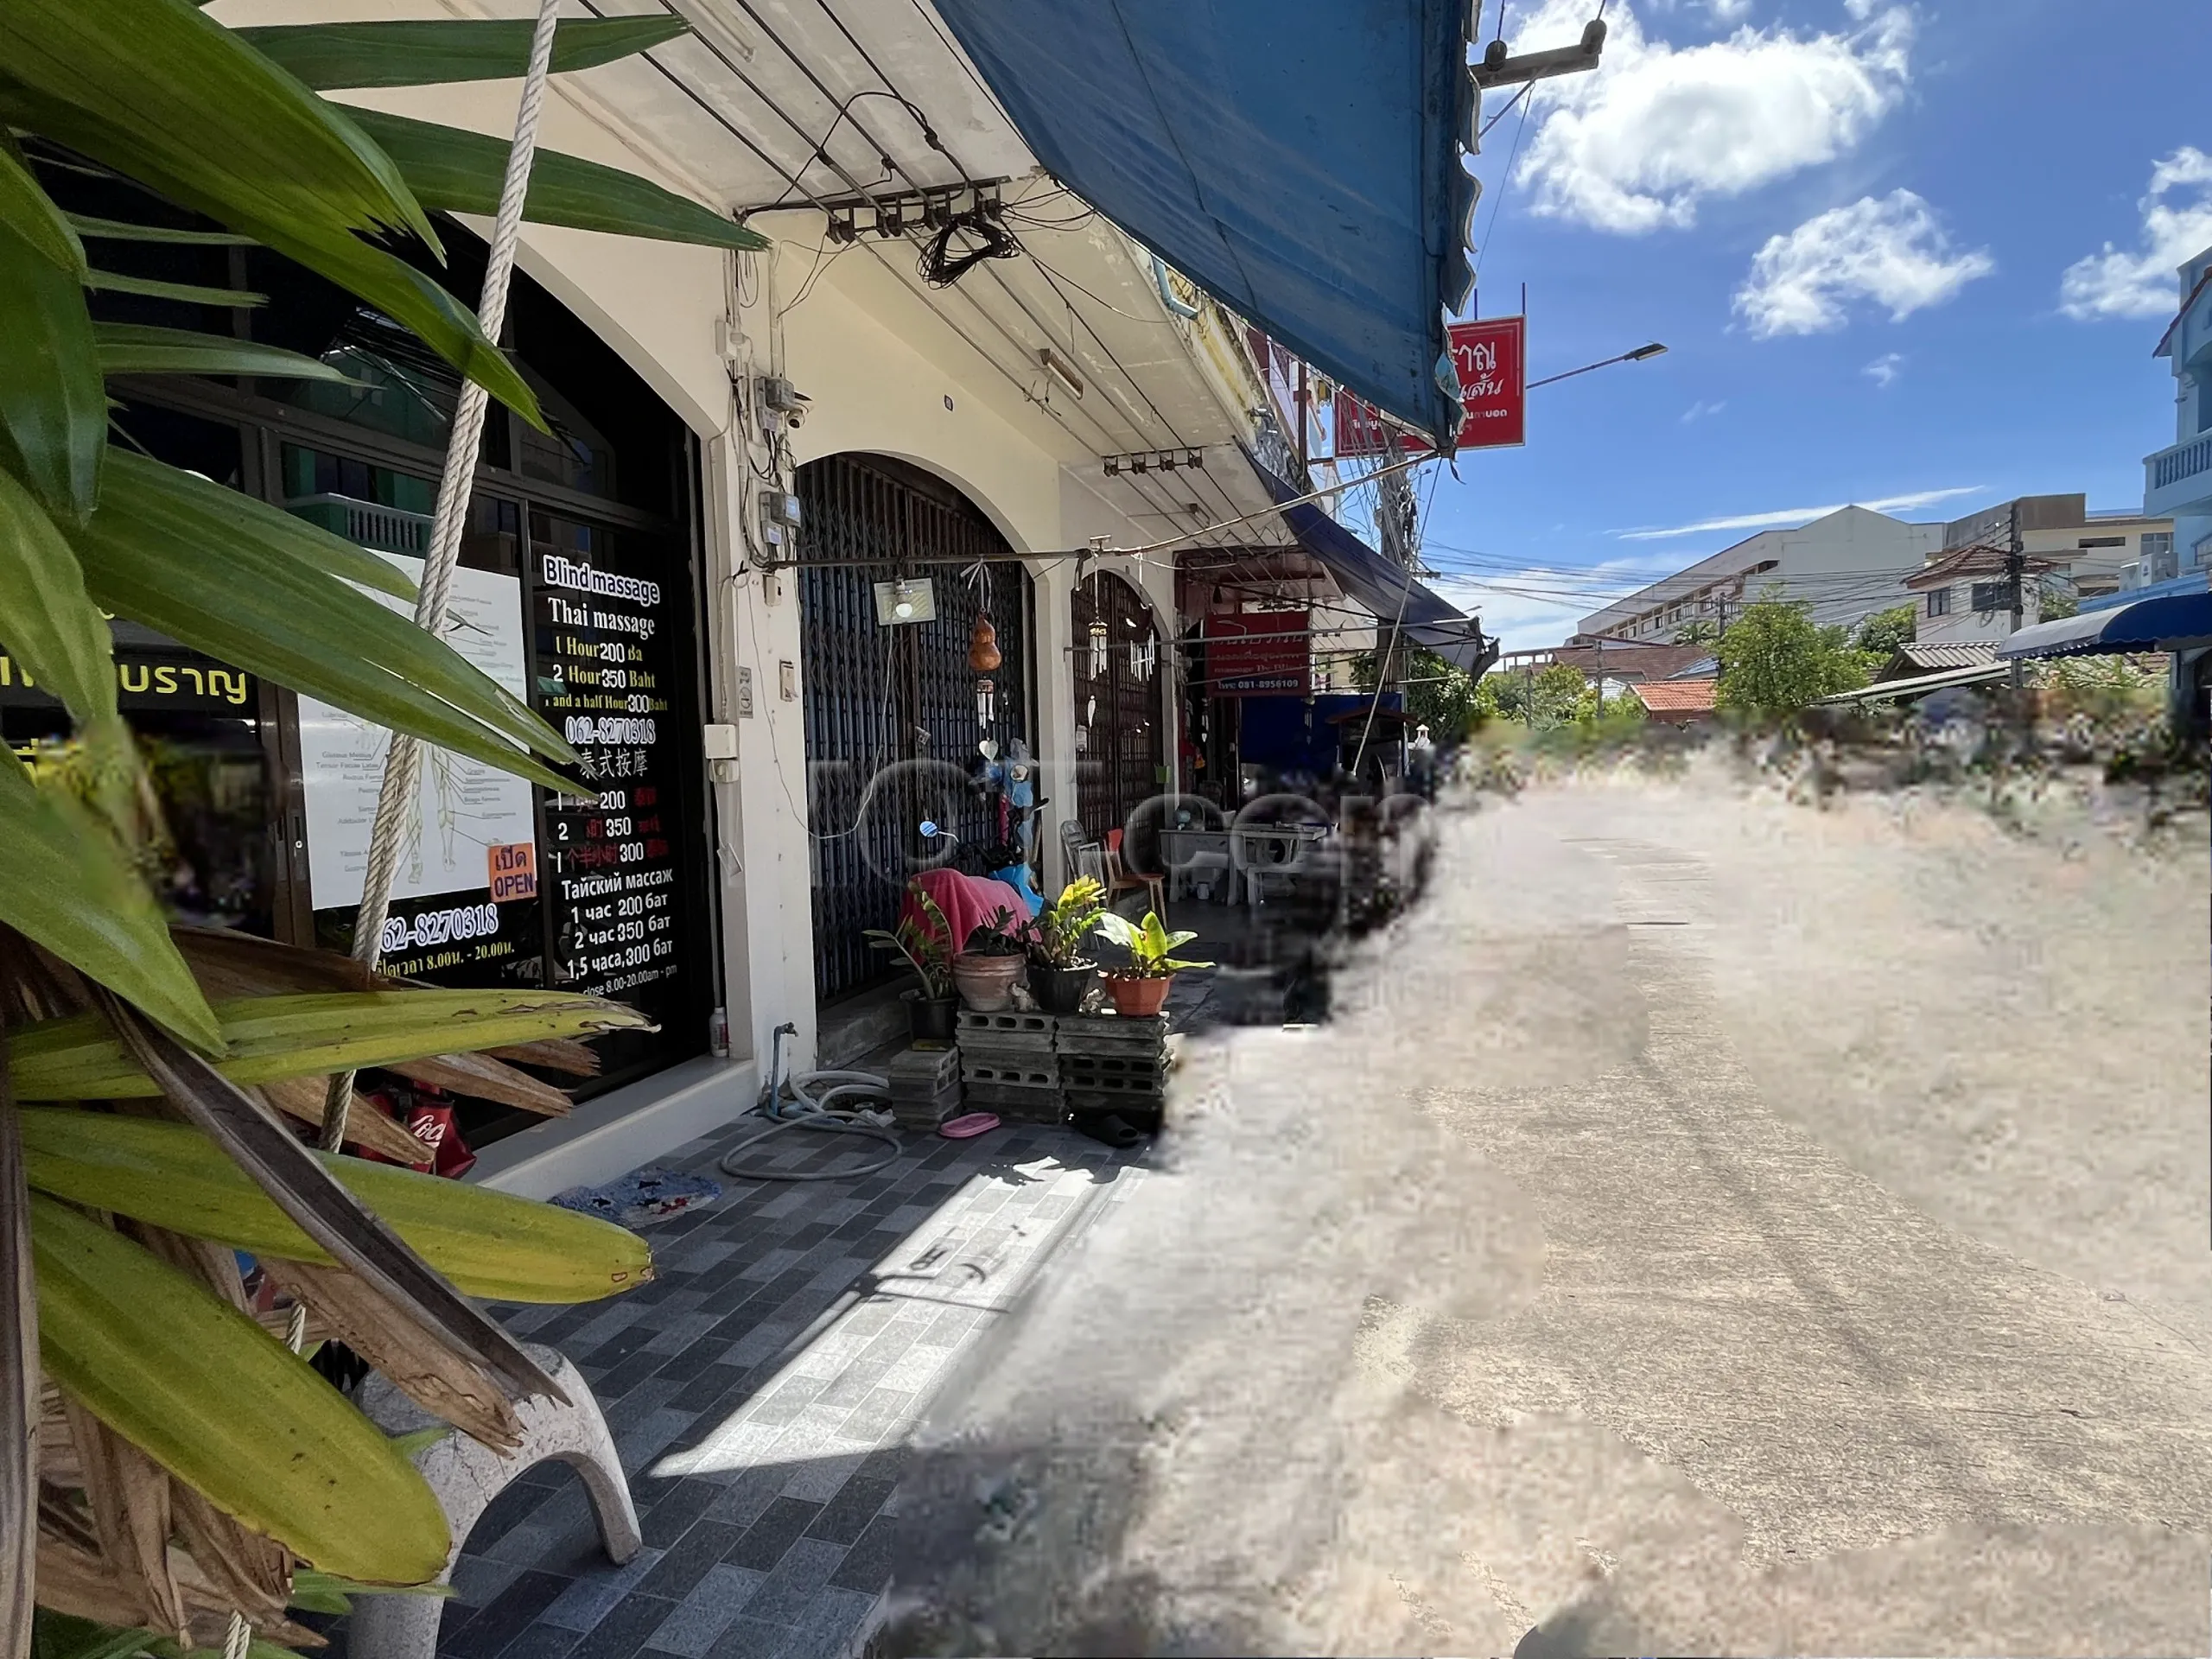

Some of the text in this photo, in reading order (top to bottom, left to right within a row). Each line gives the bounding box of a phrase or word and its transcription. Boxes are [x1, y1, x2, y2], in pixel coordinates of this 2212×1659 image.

[543, 555, 660, 607] Blind massage
[548, 597, 655, 640] Thai massage
[567, 637, 600, 658] Hour
[600, 643, 626, 663] 200
[553, 664, 656, 689] 2 Hour 350 Baht
[553, 694, 572, 708] and
[575, 697, 581, 708] a
[583, 694, 603, 709] half
[605, 696, 628, 709] Hour
[628, 694, 649, 713] 300
[649, 698, 668, 711] Baht
[565, 715, 656, 745] 062-8270318
[600, 791, 626, 810] 200
[558, 823, 569, 840] 2
[606, 817, 632, 837] 350
[495, 845, 527, 871] เปิด
[620, 842, 644, 862] 300
[494, 873, 533, 897] OPEN
[562, 868, 673, 900] Тайский массаж
[571, 893, 668, 924] 1 час 200 бат
[379, 902, 499, 953] 62-8270318
[575, 914, 671, 950] 2 час 350 бат
[568, 957, 588, 980] 1,5
[626, 944, 650, 966] 300
[653, 939, 673, 957] бат
